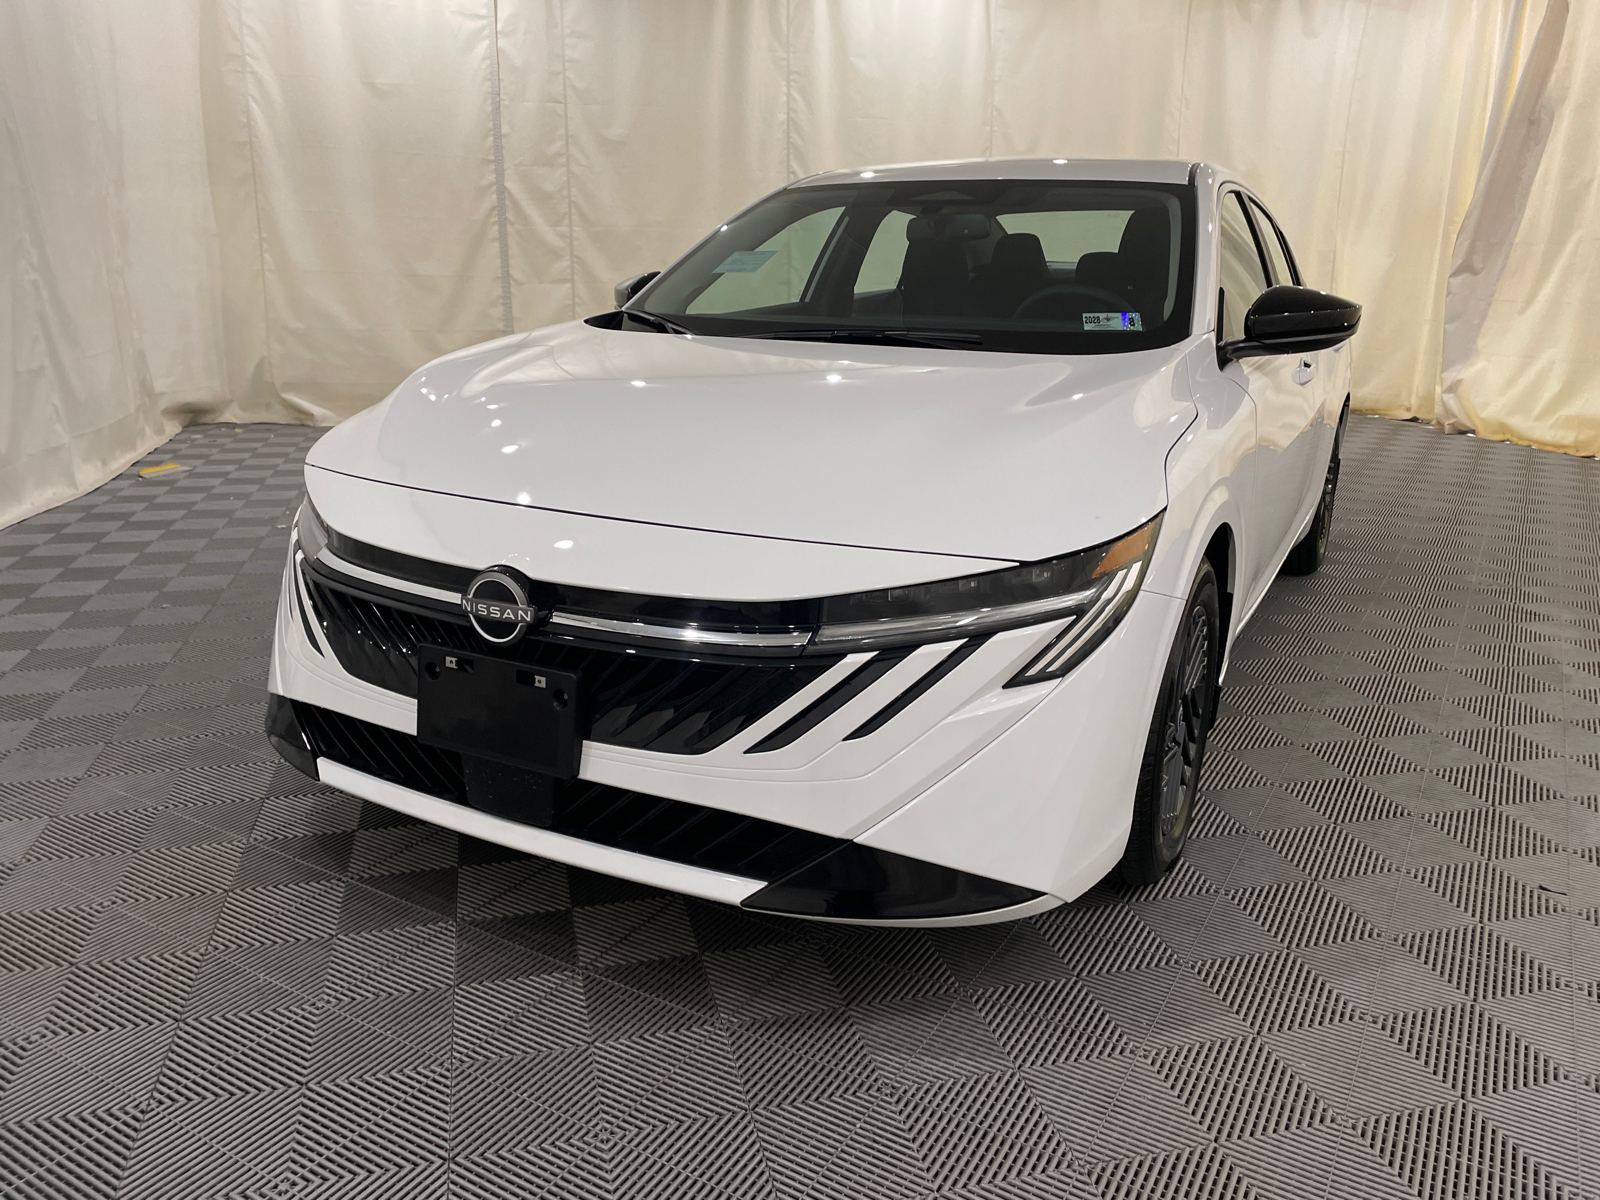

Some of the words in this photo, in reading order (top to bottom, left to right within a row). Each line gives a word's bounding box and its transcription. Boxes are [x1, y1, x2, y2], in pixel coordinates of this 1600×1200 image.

[1084, 316, 1101, 324] 2028
[1128, 317, 1135, 326] 8
[462, 599, 531, 621] NISSAN
